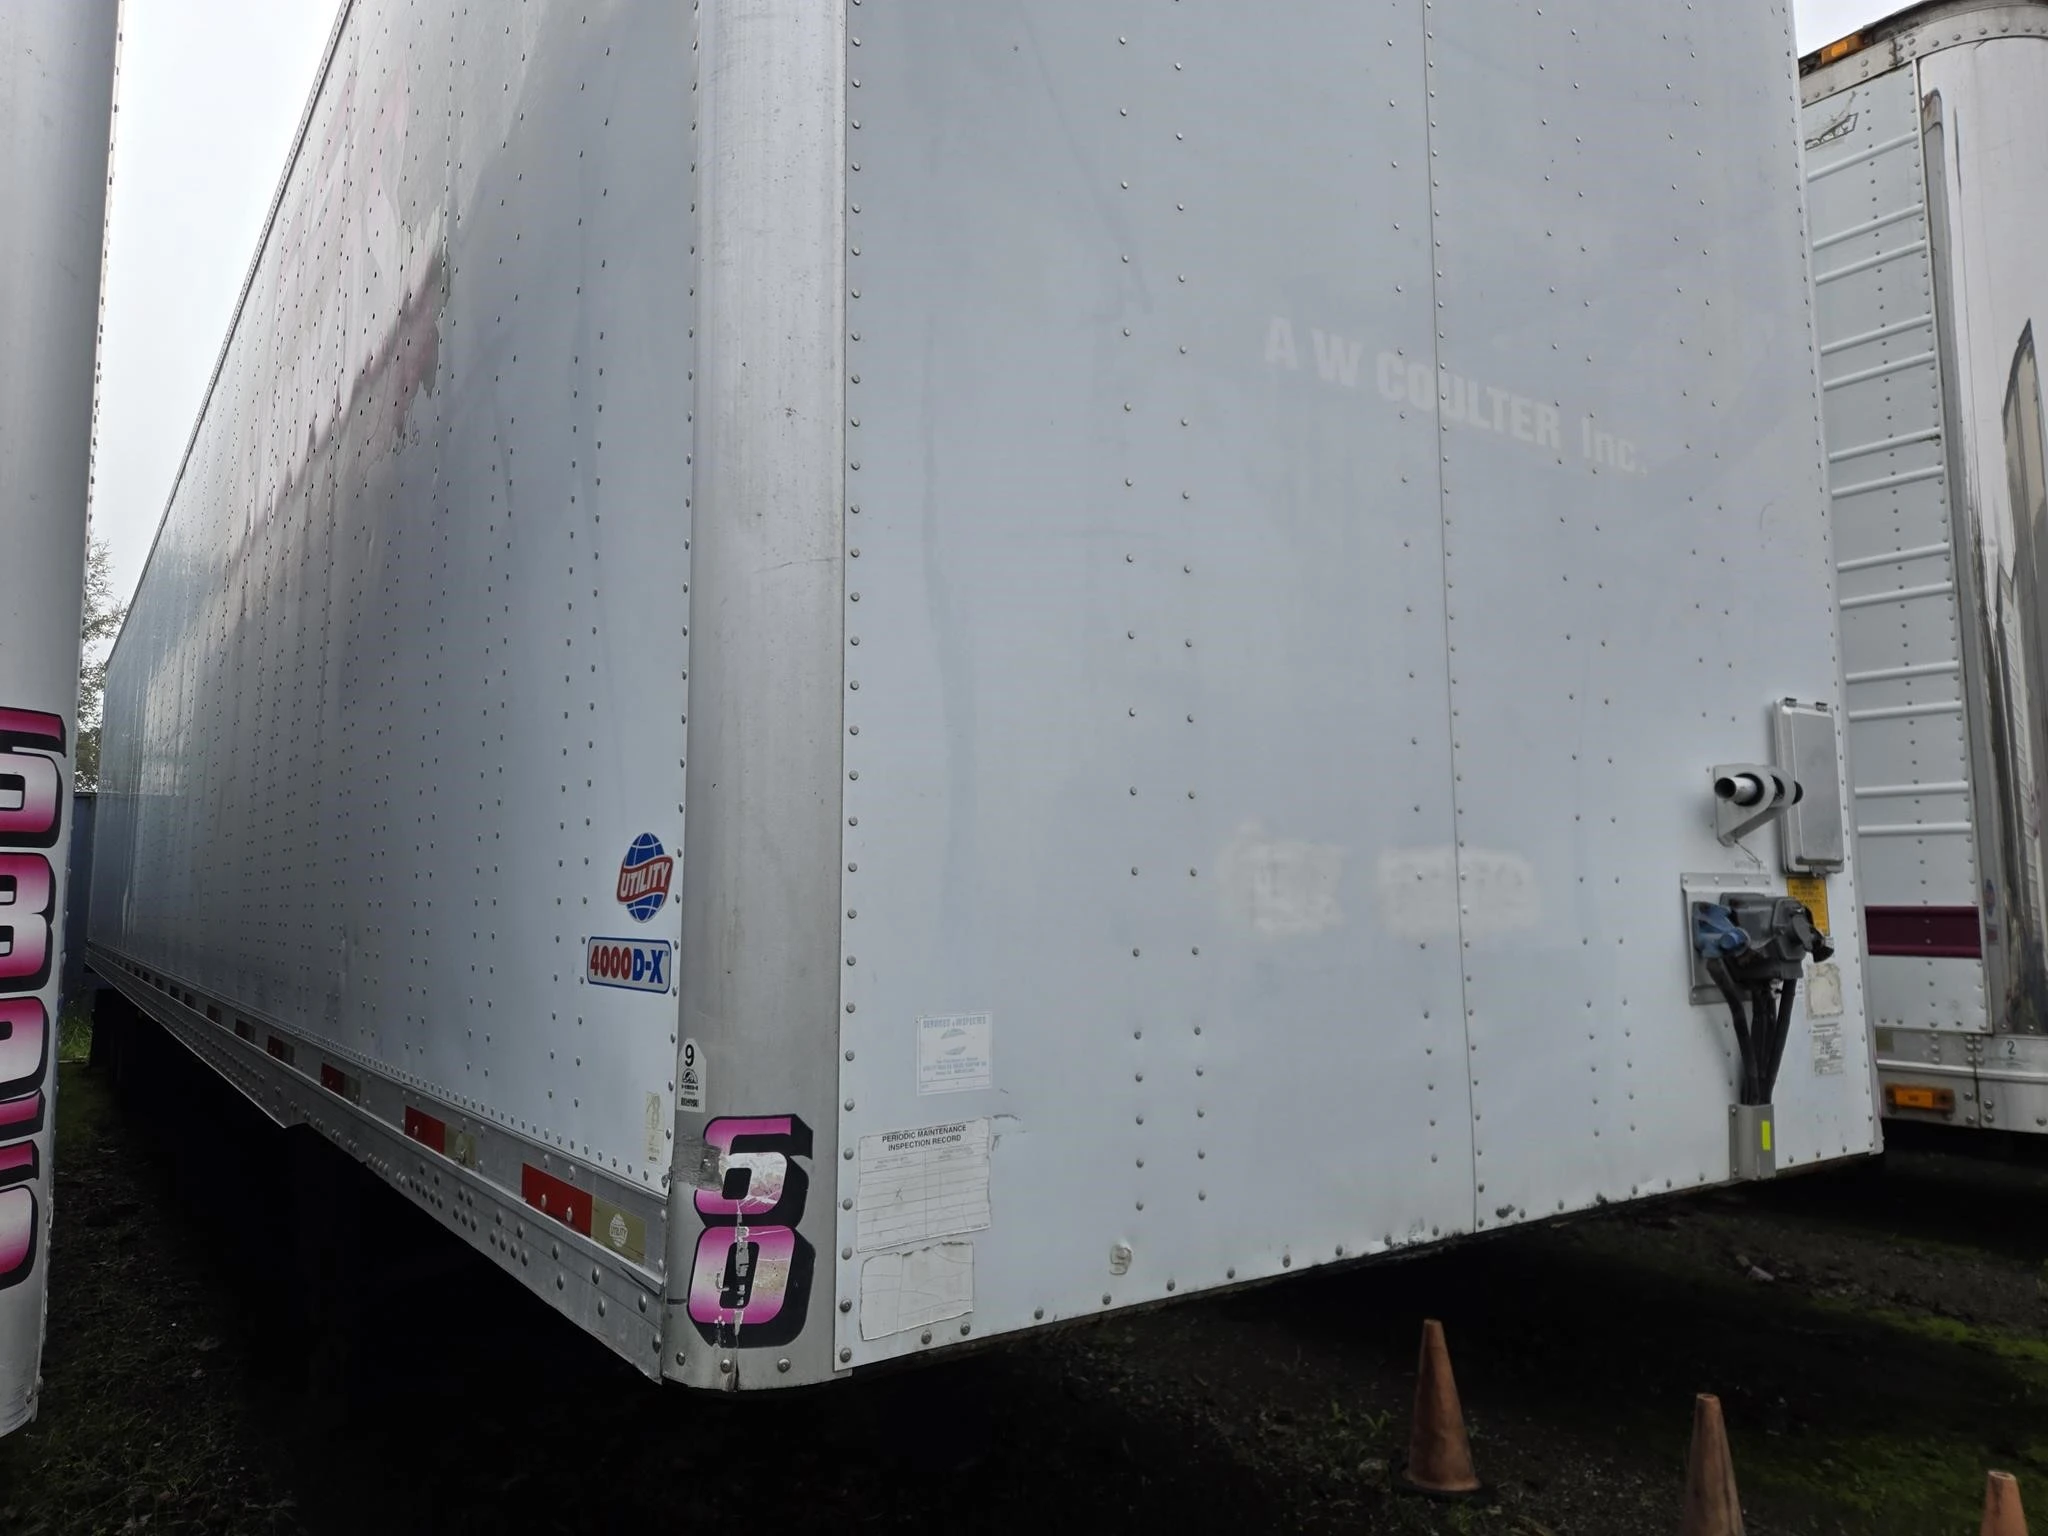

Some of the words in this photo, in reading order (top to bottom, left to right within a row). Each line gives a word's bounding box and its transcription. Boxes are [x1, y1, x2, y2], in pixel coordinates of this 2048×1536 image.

[1264, 316, 1299, 370] A
[1311, 327, 1365, 387] W
[1376, 350, 1562, 450] COULTER
[620, 861, 671, 898] UTILITY
[590, 945, 664, 984] 4000D-X
[685, 1044, 694, 1067] 9
[2007, 1040, 2016, 1055] 2
[881, 1131, 916, 1144] PERIODIC
[917, 1123, 967, 1139] MAINTENANCE
[888, 1138, 931, 1152] INSPECTION
[932, 1133, 962, 1146] RECORD
